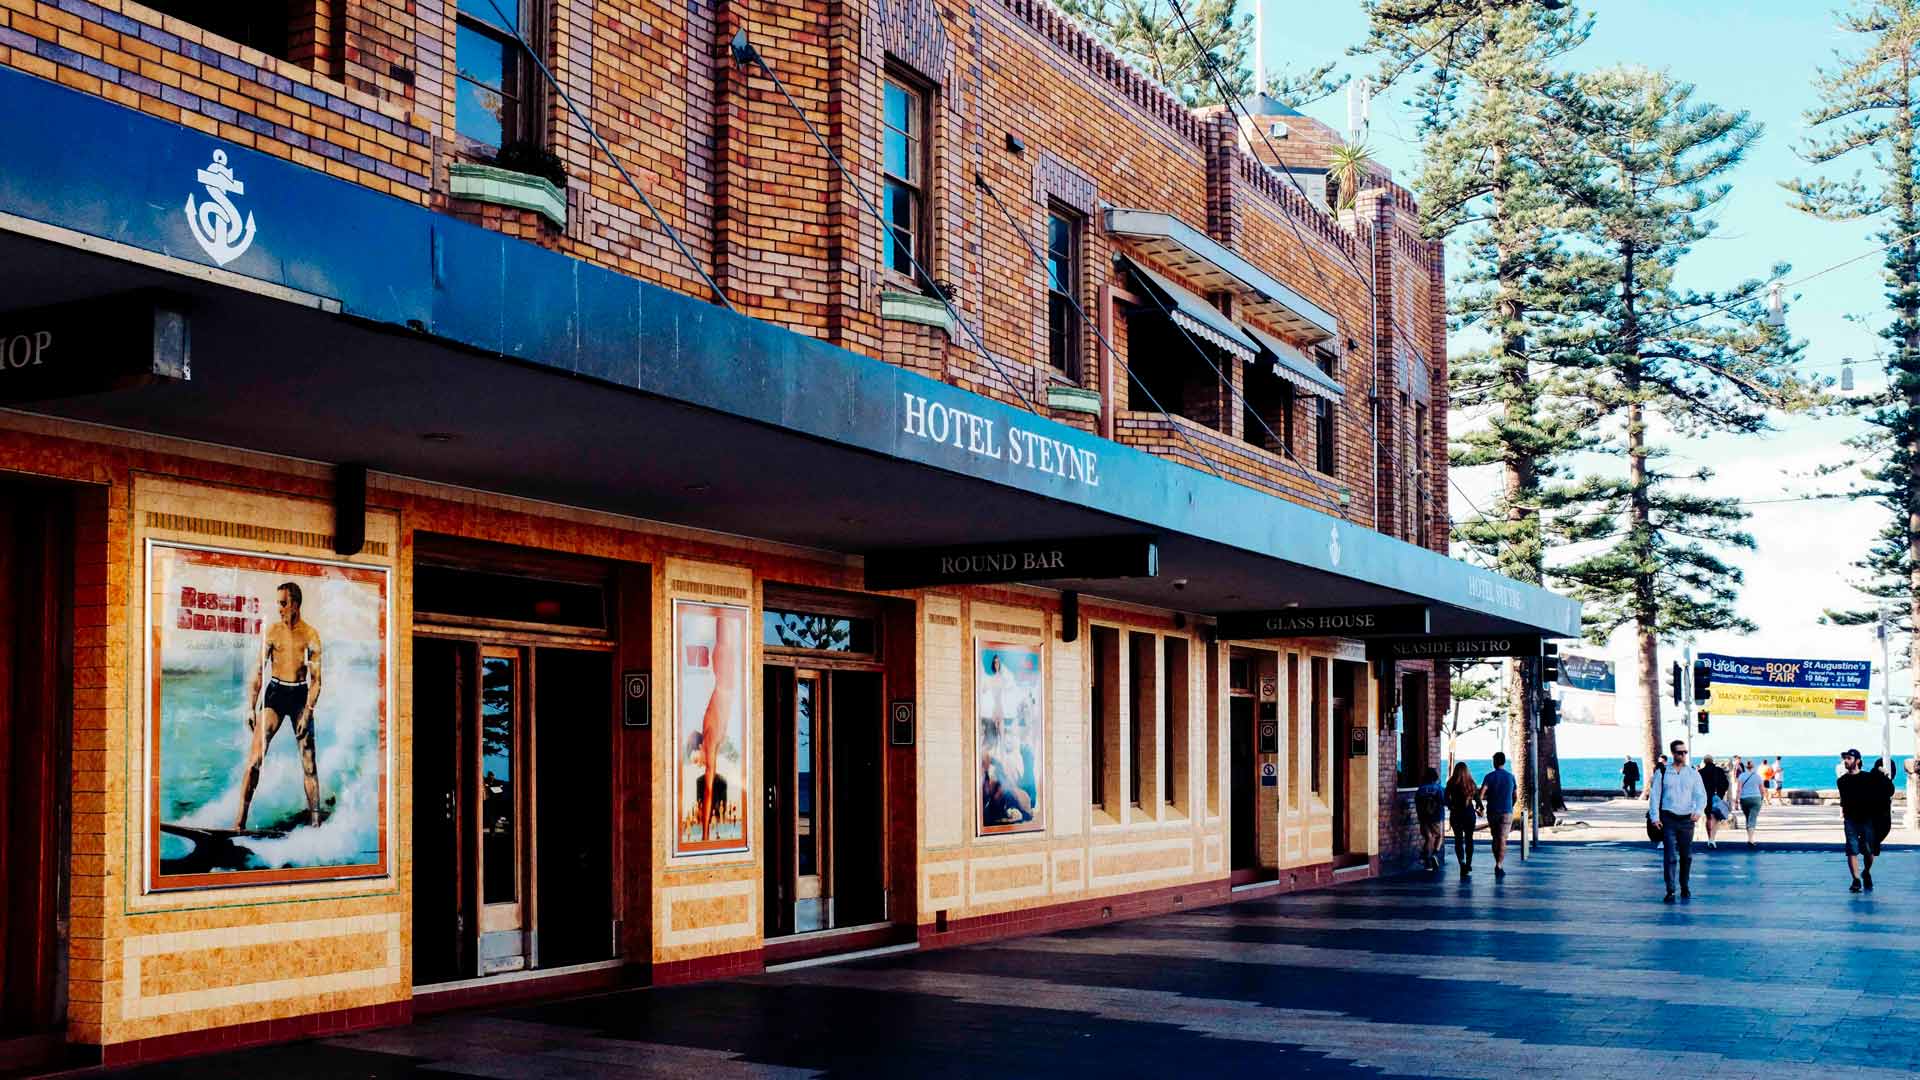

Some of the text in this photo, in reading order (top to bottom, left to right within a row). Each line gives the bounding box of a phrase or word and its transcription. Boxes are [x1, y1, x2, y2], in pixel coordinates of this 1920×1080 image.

[903, 392, 1099, 487] HOTEL STEYNE
[941, 551, 1065, 575] ROUND BAR
[1266, 613, 1376, 630] GLASS HOUSE
[1393, 640, 1511, 655] SEASIDE BISTRO
[1712, 659, 1750, 674] Lifeline
[1766, 662, 1800, 673] BOOK
[1803, 660, 1866, 671] St Augustine's
[1769, 672, 1795, 683] FAIR
[1805, 674, 1813, 682] 19
[1815, 675, 1829, 683] May
[1847, 676, 1861, 684] May
[1771, 695, 1786, 703] FUN
